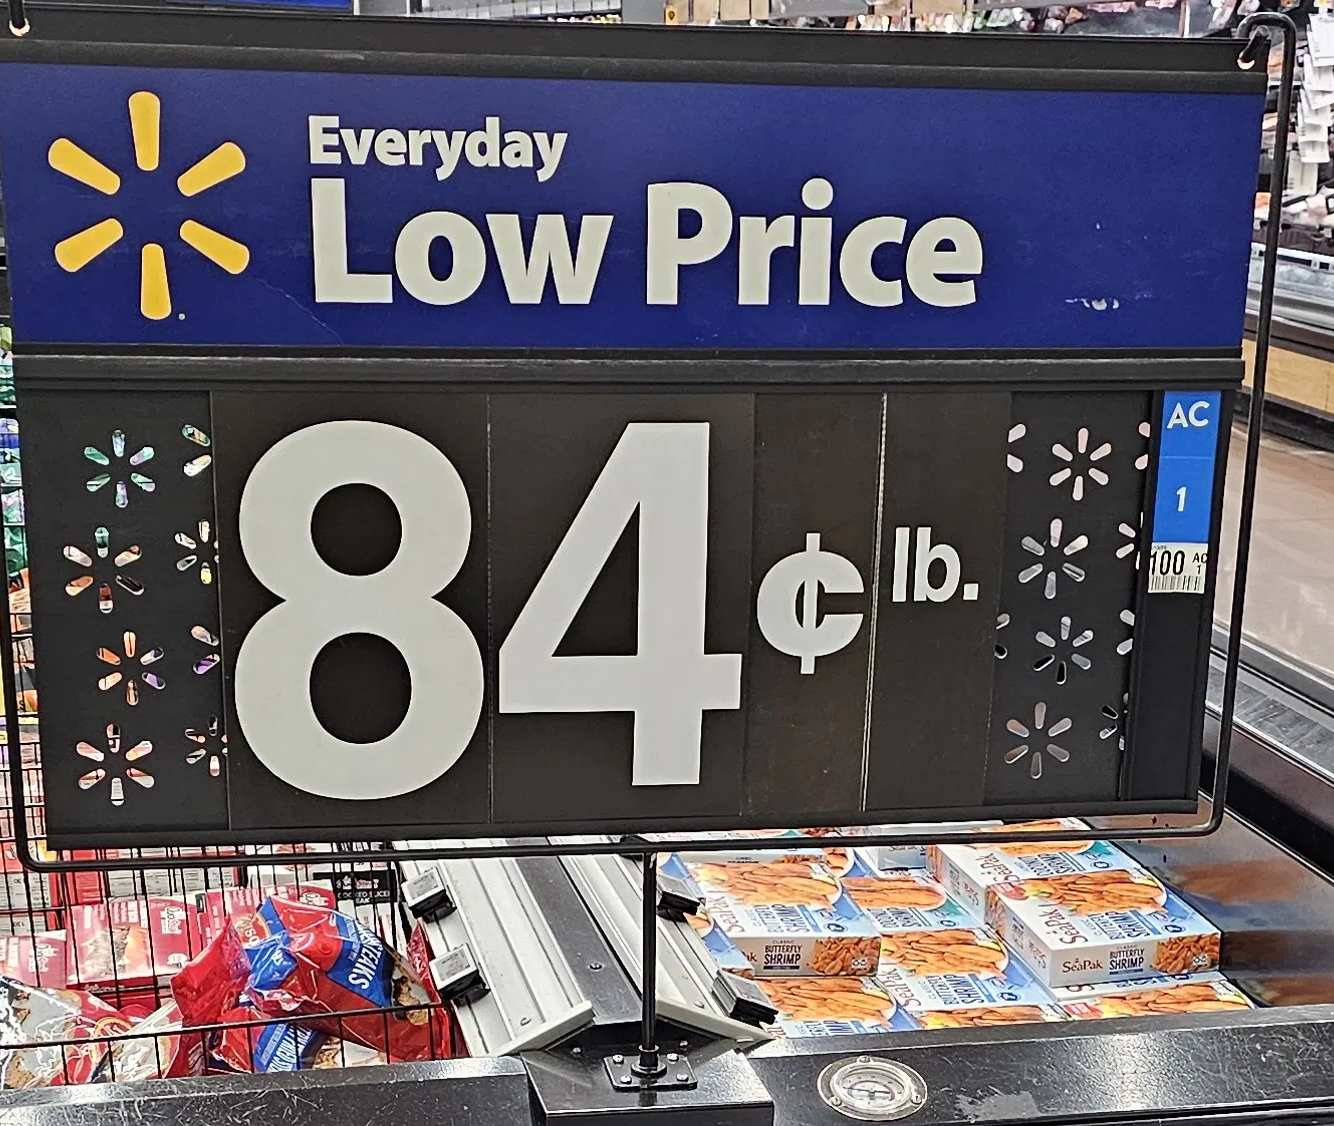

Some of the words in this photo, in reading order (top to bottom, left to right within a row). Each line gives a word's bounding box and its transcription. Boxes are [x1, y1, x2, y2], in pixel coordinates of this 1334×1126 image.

[308, 115, 567, 184] Everyday
[311, 177, 613, 305] Low
[645, 176, 984, 307] Price
[1167, 401, 1210, 429] AC
[1176, 487, 1187, 512] 1
[892, 527, 980, 604] lb.
[1150, 550, 1186, 576] 100
[1192, 552, 1208, 564] AC
[1039, 904, 1090, 945] SeaPak
[764, 954, 802, 966] SHRIMP
[765, 945, 802, 954] BUTTERFLY
[1110, 948, 1145, 960] BUTTERFLY
[1062, 958, 1104, 974] SeaPak
[1109, 958, 1144, 971] SHRIMP
